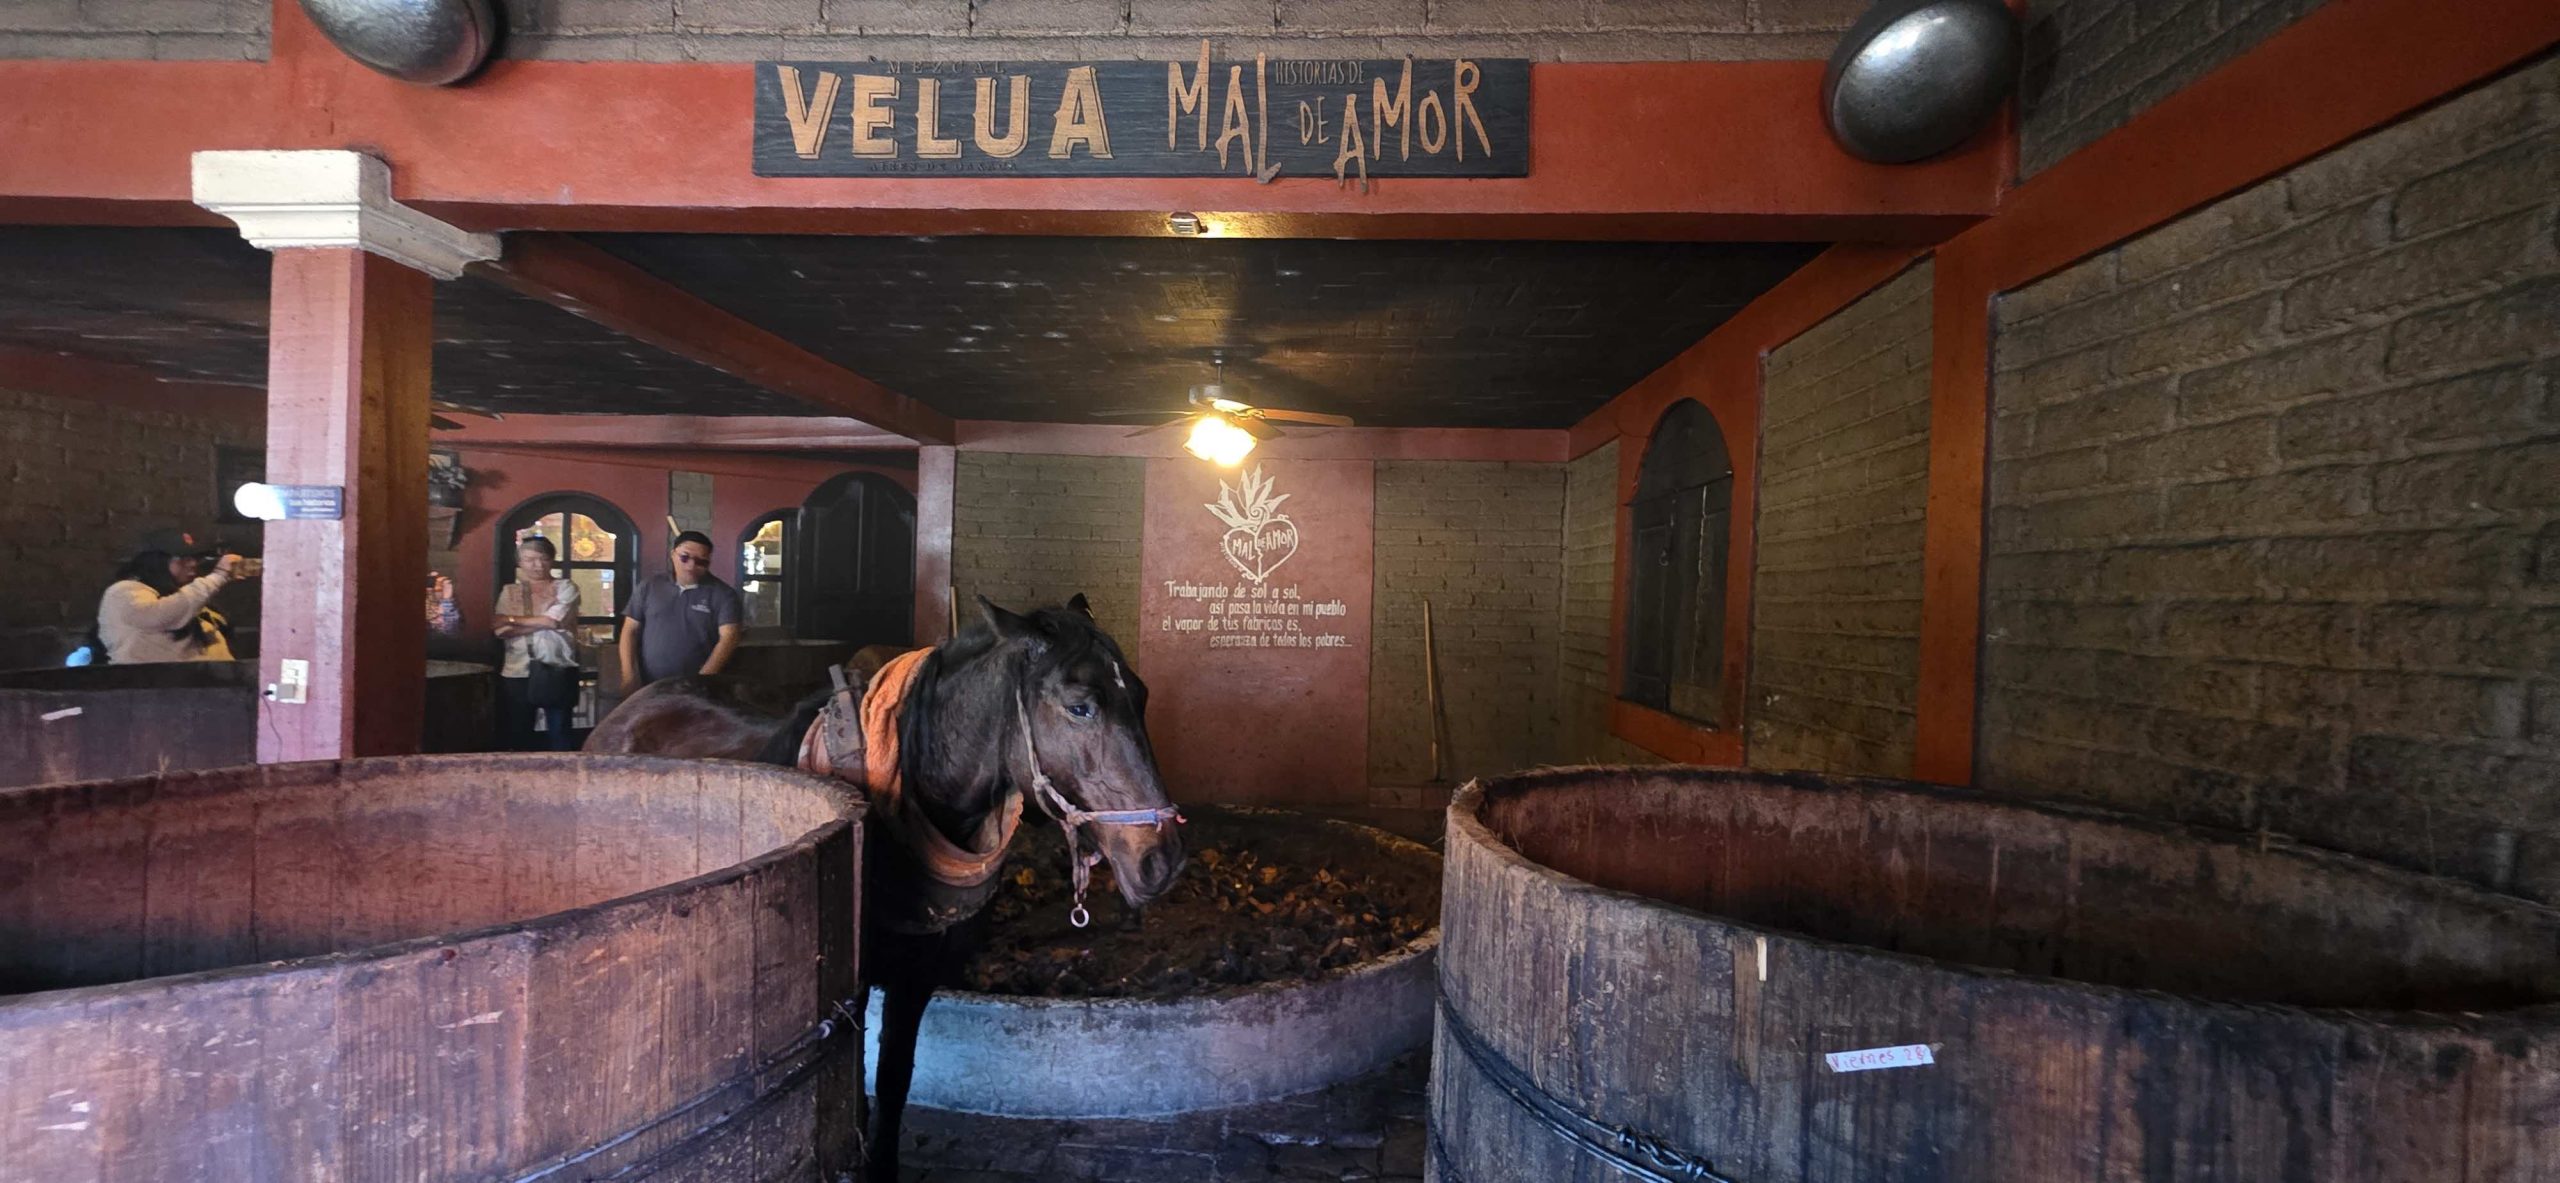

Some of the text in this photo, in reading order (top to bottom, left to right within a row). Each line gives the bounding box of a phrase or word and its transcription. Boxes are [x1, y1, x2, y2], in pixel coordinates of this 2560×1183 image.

[1275, 60, 1365, 84] HISTORIAS DE
[777, 64, 1114, 160] VELUA
[1168, 39, 1492, 193] MAL DE AMOR
[1231, 538, 1256, 561] MAL
[1265, 528, 1295, 551] AMOR
[1164, 580, 1229, 602] Trabajando
[1233, 582, 1247, 598] de
[1250, 582, 1268, 599] sol
[1271, 587, 1280, 599] a
[1208, 599, 1347, 620] así pasa la vida en mi pueblo
[1162, 615, 1171, 631] el
[1175, 619, 1204, 635] vapor
[1207, 615, 1219, 631] de
[1222, 616, 1240, 631] tus
[1259, 631, 1271, 648] de
[1272, 631, 1297, 648] todos
[1298, 631, 1312, 648] los
[1831, 1050, 1895, 1069] Viernes
